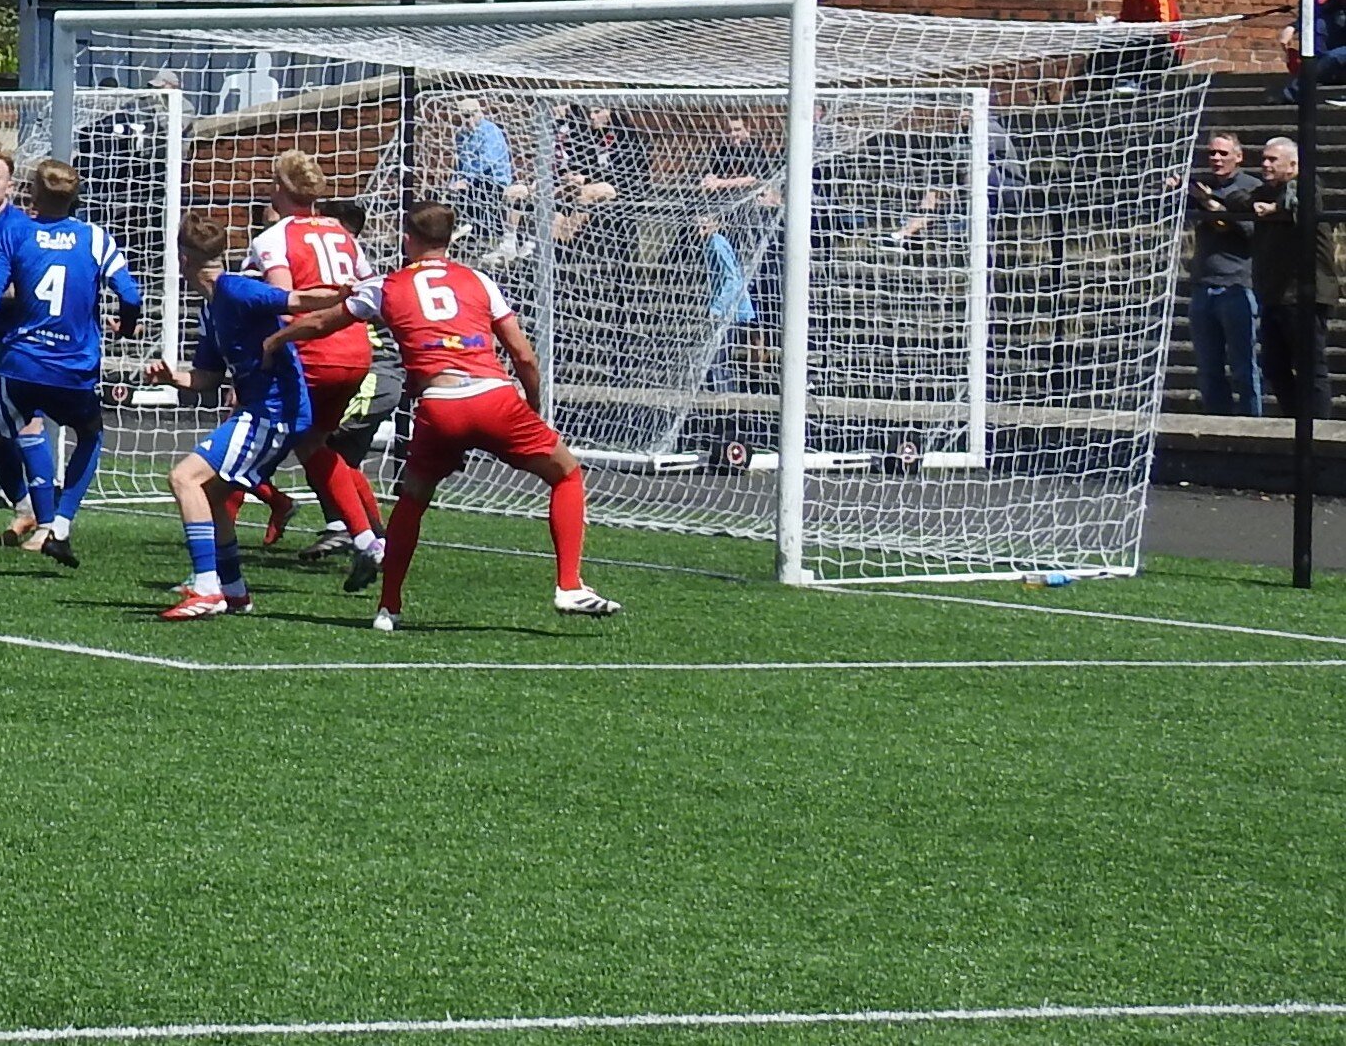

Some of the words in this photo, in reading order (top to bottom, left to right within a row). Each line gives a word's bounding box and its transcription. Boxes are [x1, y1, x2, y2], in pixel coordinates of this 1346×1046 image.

[303, 232, 356, 286] 16
[34, 264, 66, 316] 4
[413, 268, 459, 322] 6
